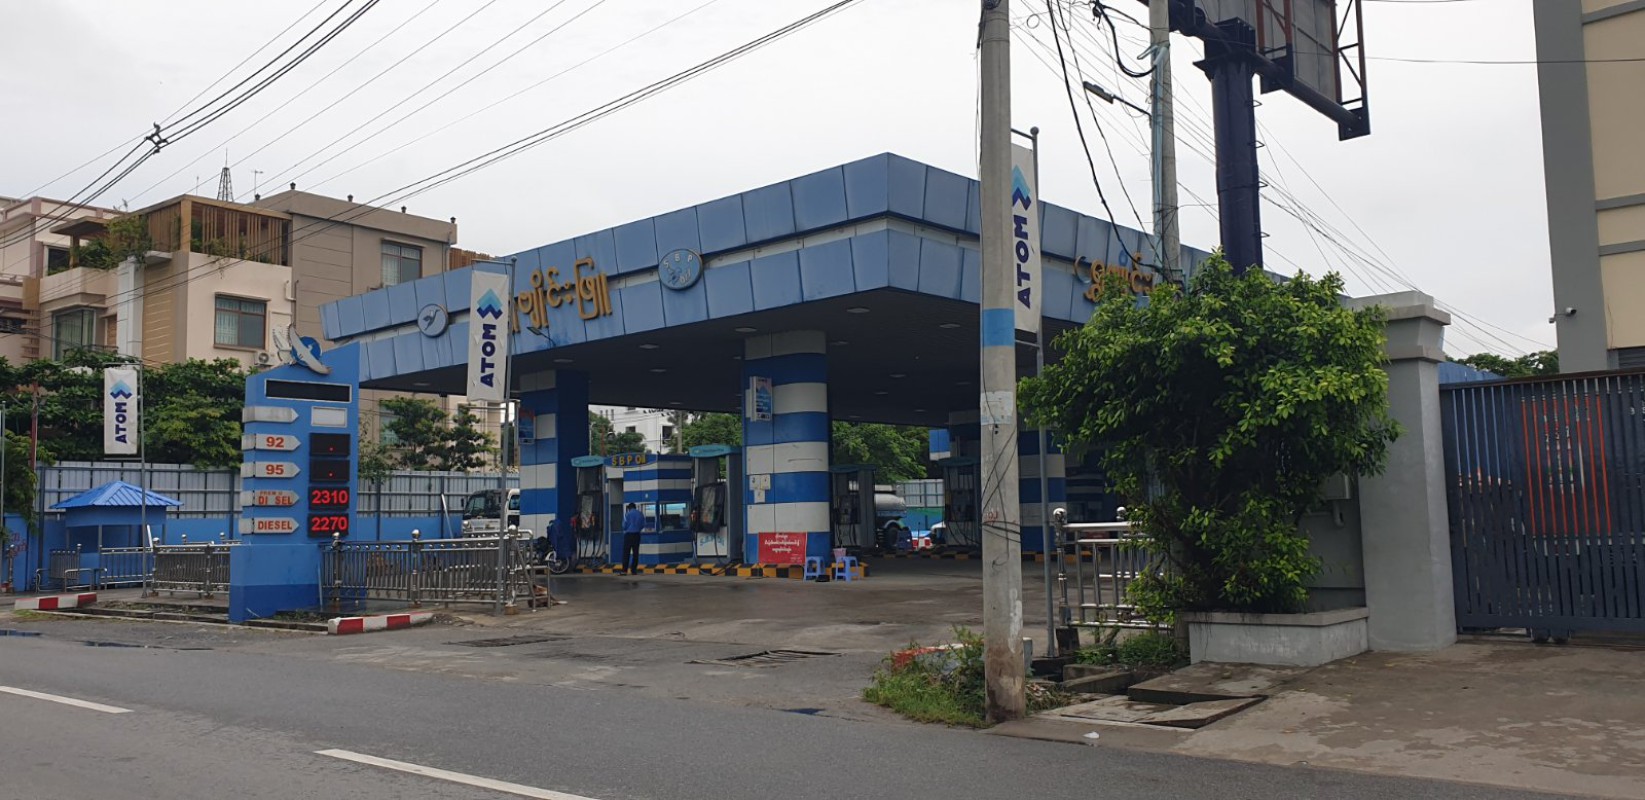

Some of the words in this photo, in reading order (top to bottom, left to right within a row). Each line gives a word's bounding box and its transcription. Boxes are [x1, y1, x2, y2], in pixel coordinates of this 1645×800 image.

[1013, 214, 1031, 309] ATOM
[480, 324, 497, 388] ATOM
[115, 402, 127, 444] ATOM
[266, 436, 284, 448] 92
[265, 464, 284, 475] 95
[311, 489, 348, 504] 2310
[257, 520, 293, 530] DIESEL
[311, 516, 348, 531] 2270
